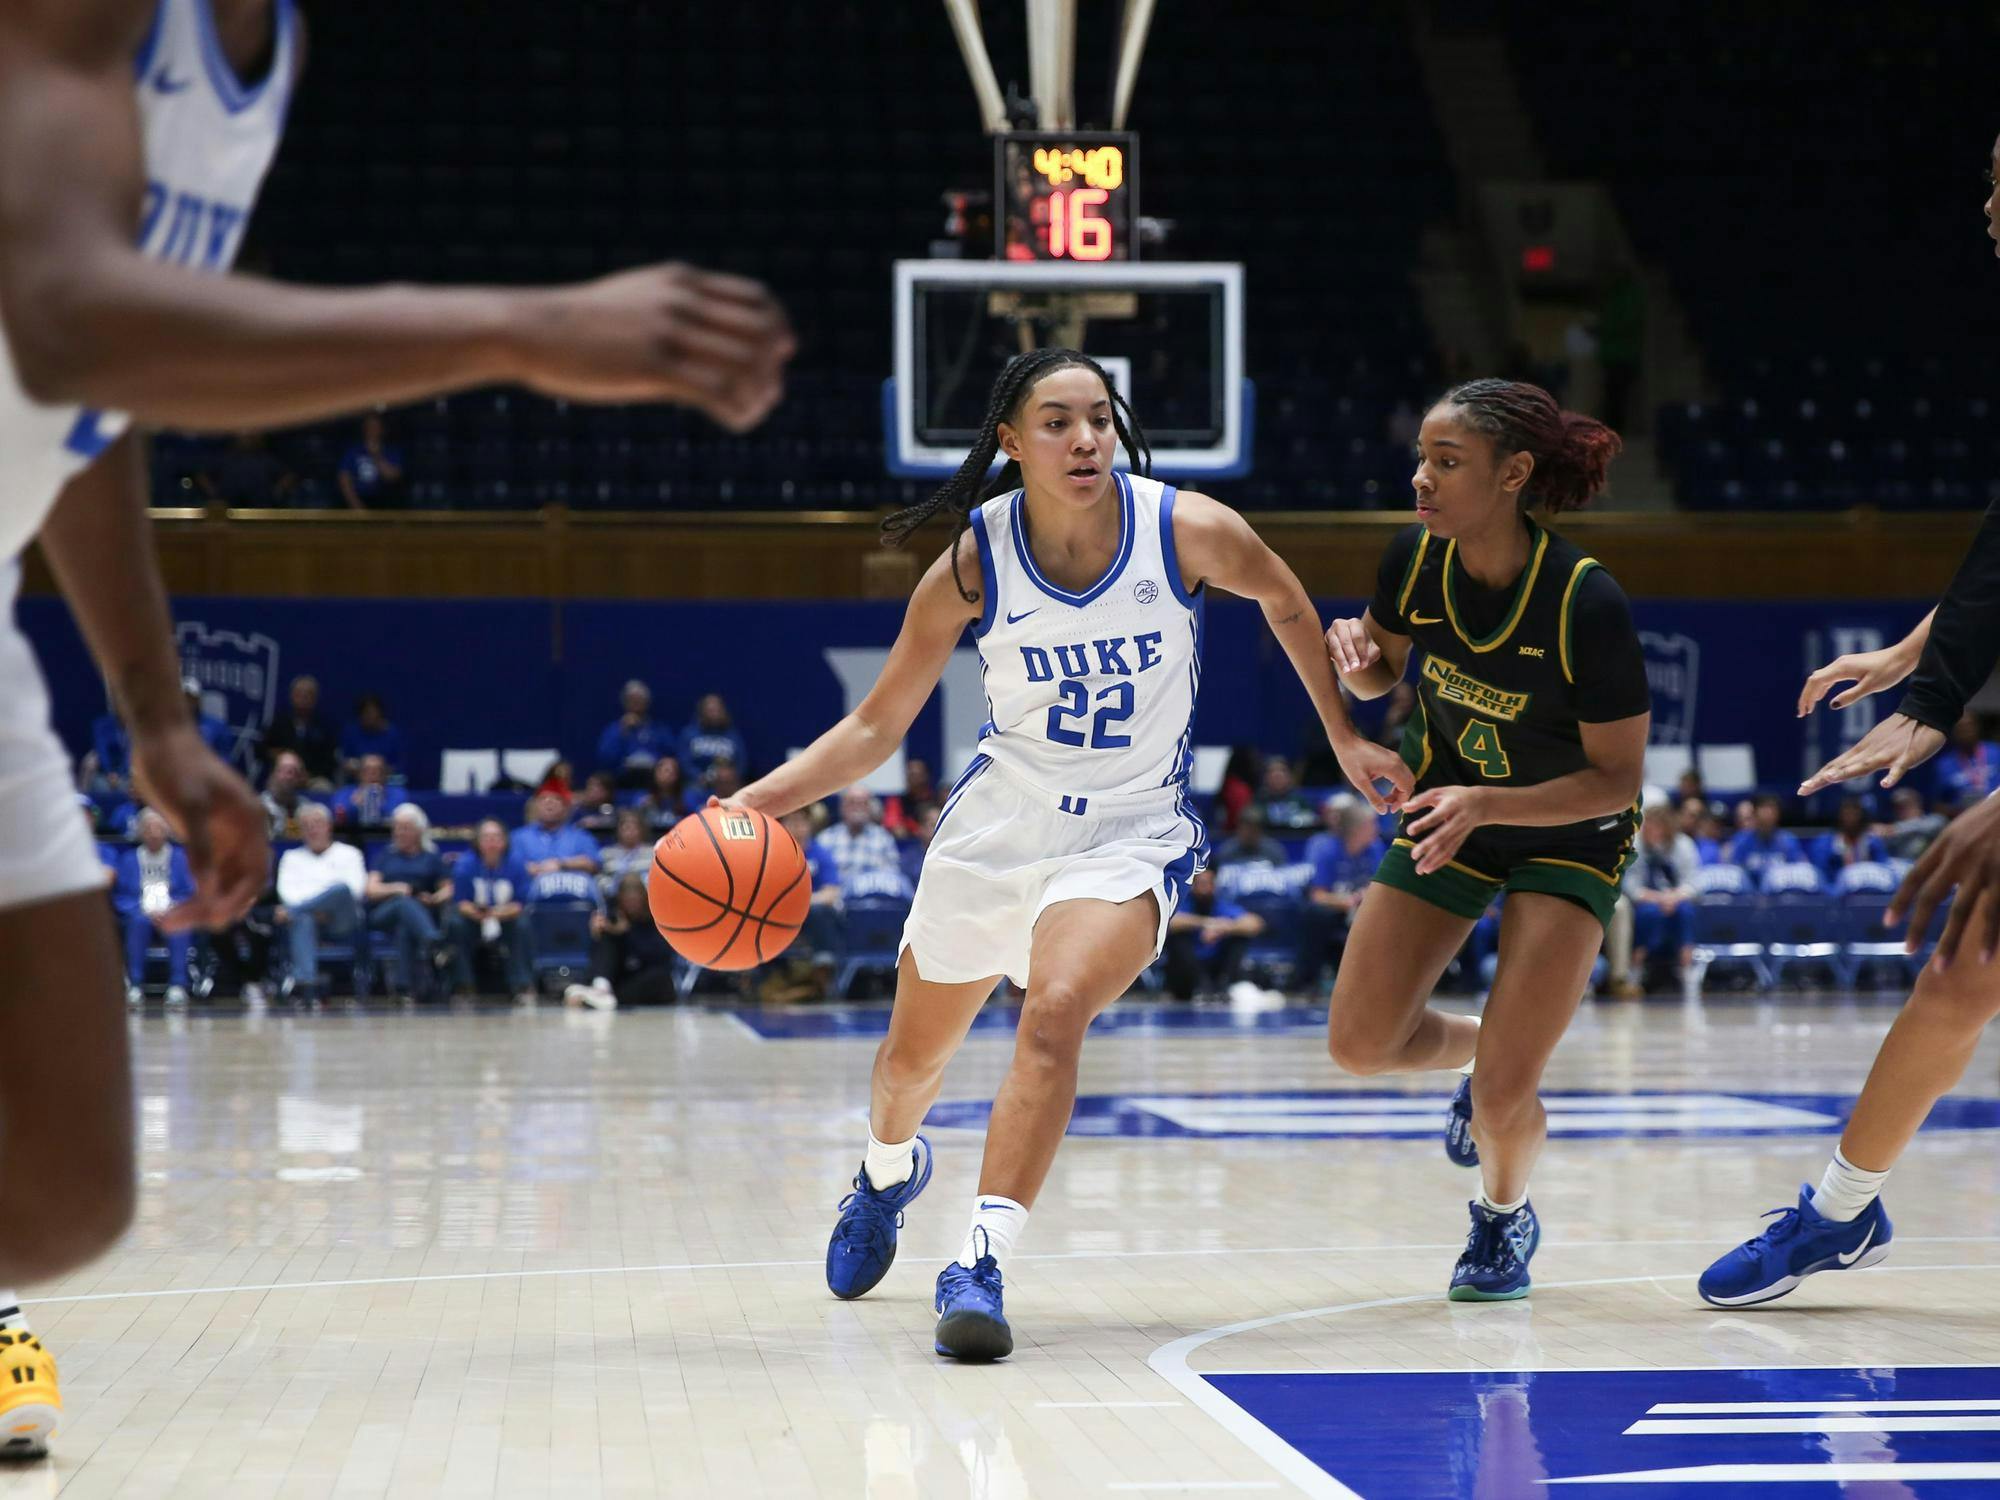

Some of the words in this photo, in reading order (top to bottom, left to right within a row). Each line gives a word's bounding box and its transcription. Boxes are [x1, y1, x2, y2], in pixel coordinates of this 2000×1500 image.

[1034, 146, 1123, 190] 4:40
[1048, 188, 1113, 261] 16
[1136, 585, 1157, 596] ACC
[1019, 630, 1163, 682] DUKE
[1426, 660, 1523, 707] NORFOLK
[1441, 683, 1515, 716] STATE
[1046, 679, 1135, 749] 22
[1457, 718, 1511, 778] 4
